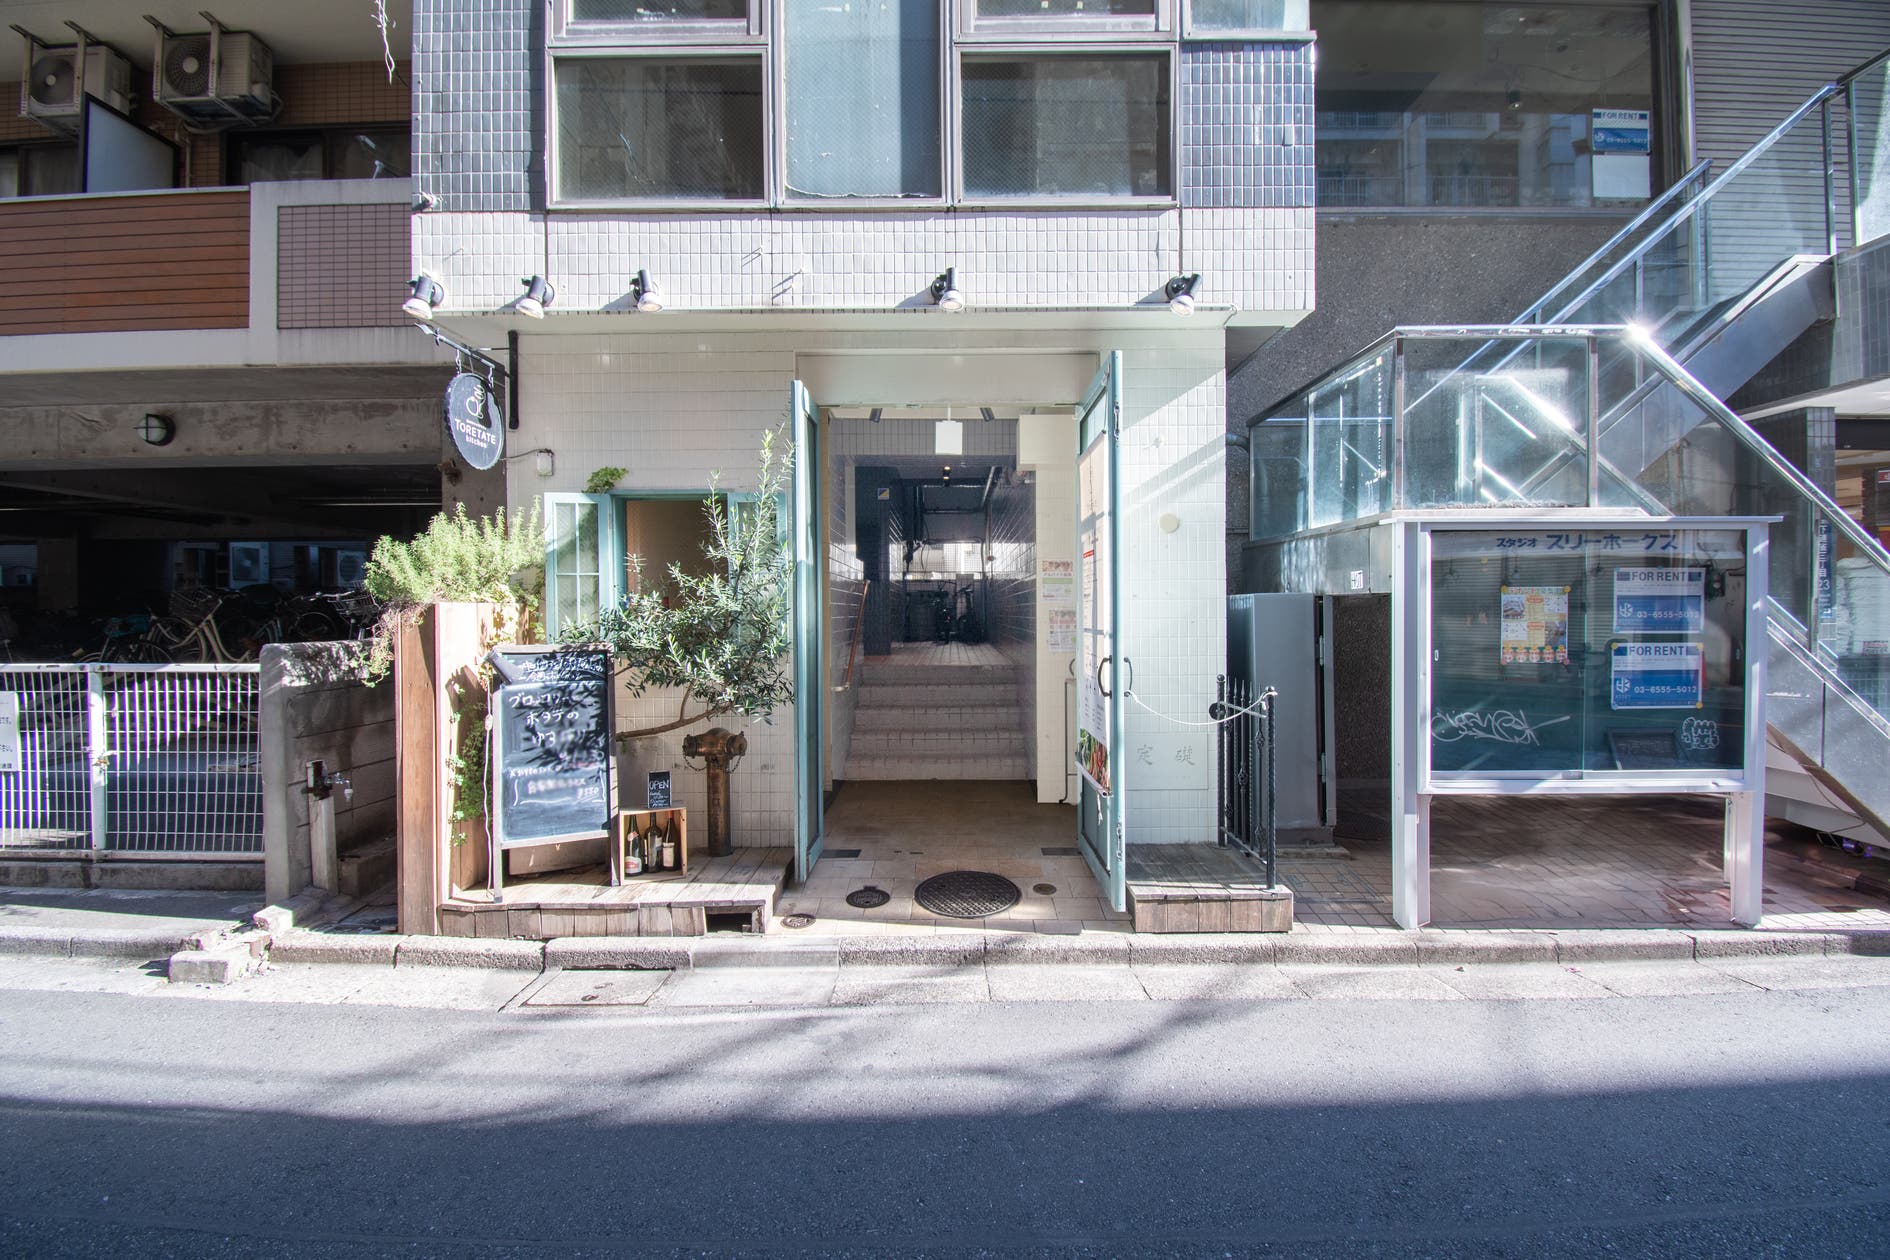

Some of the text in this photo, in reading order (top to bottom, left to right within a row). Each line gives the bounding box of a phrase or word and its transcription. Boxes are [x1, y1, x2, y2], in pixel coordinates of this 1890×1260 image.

[1618, 112, 1638, 120] RENT
[454, 418, 496, 444] TORETATE
[465, 435, 488, 449] kitchen
[1496, 533, 1679, 550] スタジオ スリーホークス
[1631, 571, 1686, 581] FOR RENT
[1628, 645, 1685, 656] FOR RENT
[1633, 685, 1697, 693] 03-6555-5012
[649, 779, 669, 790] OPEN
